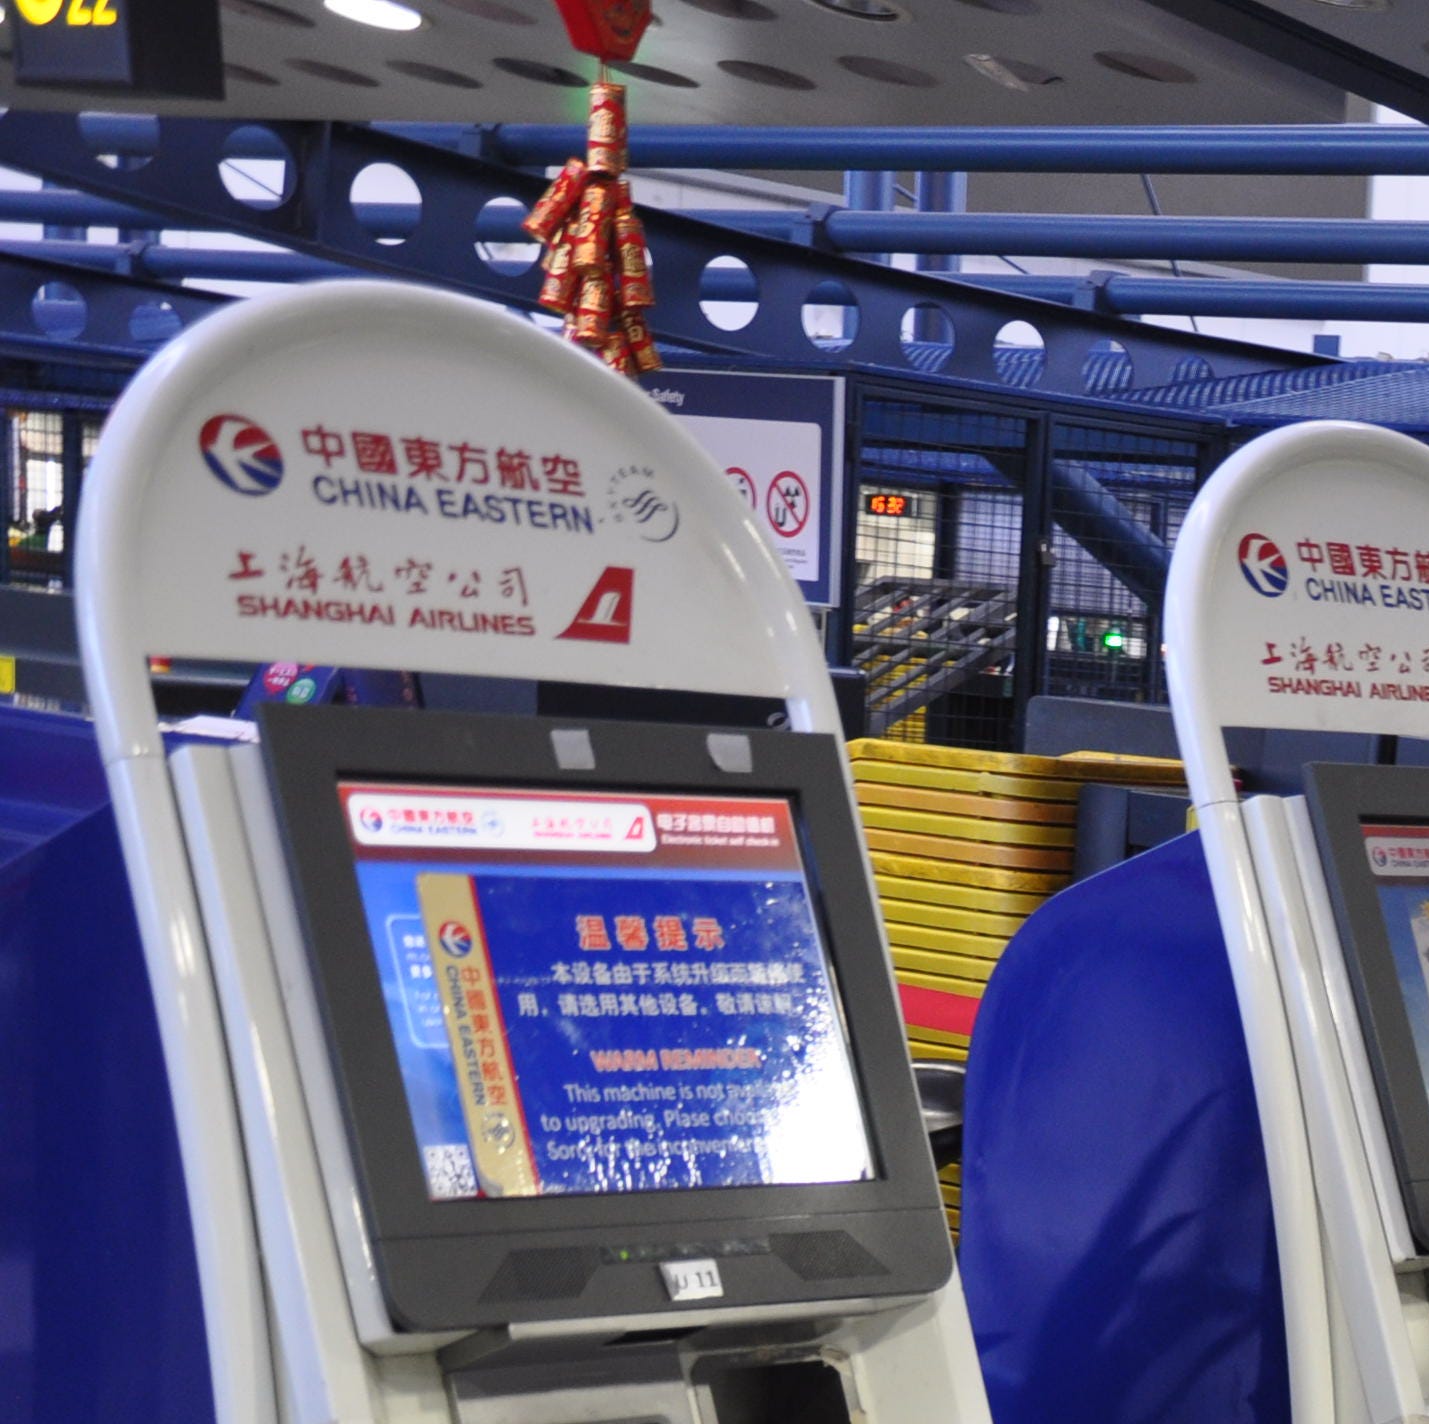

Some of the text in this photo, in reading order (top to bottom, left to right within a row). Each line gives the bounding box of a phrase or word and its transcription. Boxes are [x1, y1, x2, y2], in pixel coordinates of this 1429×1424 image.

[302, 425, 587, 498] 中國東方航空
[312, 474, 594, 535] CHINA EASTERN
[228, 546, 530, 606] 上海航空公司
[1305, 577, 1376, 607] CHINA
[237, 595, 536, 637] SHANGHAI AIRLINES
[1267, 676, 1362, 699] SHANGHAI
[576, 915, 725, 951] 温馨提示
[590, 1050, 658, 1072] WARM
[563, 1083, 600, 1102] This
[604, 1083, 676, 1102] machine
[680, 1083, 693, 1100] is
[697, 1083, 724, 1100] not
[540, 1114, 561, 1132] to
